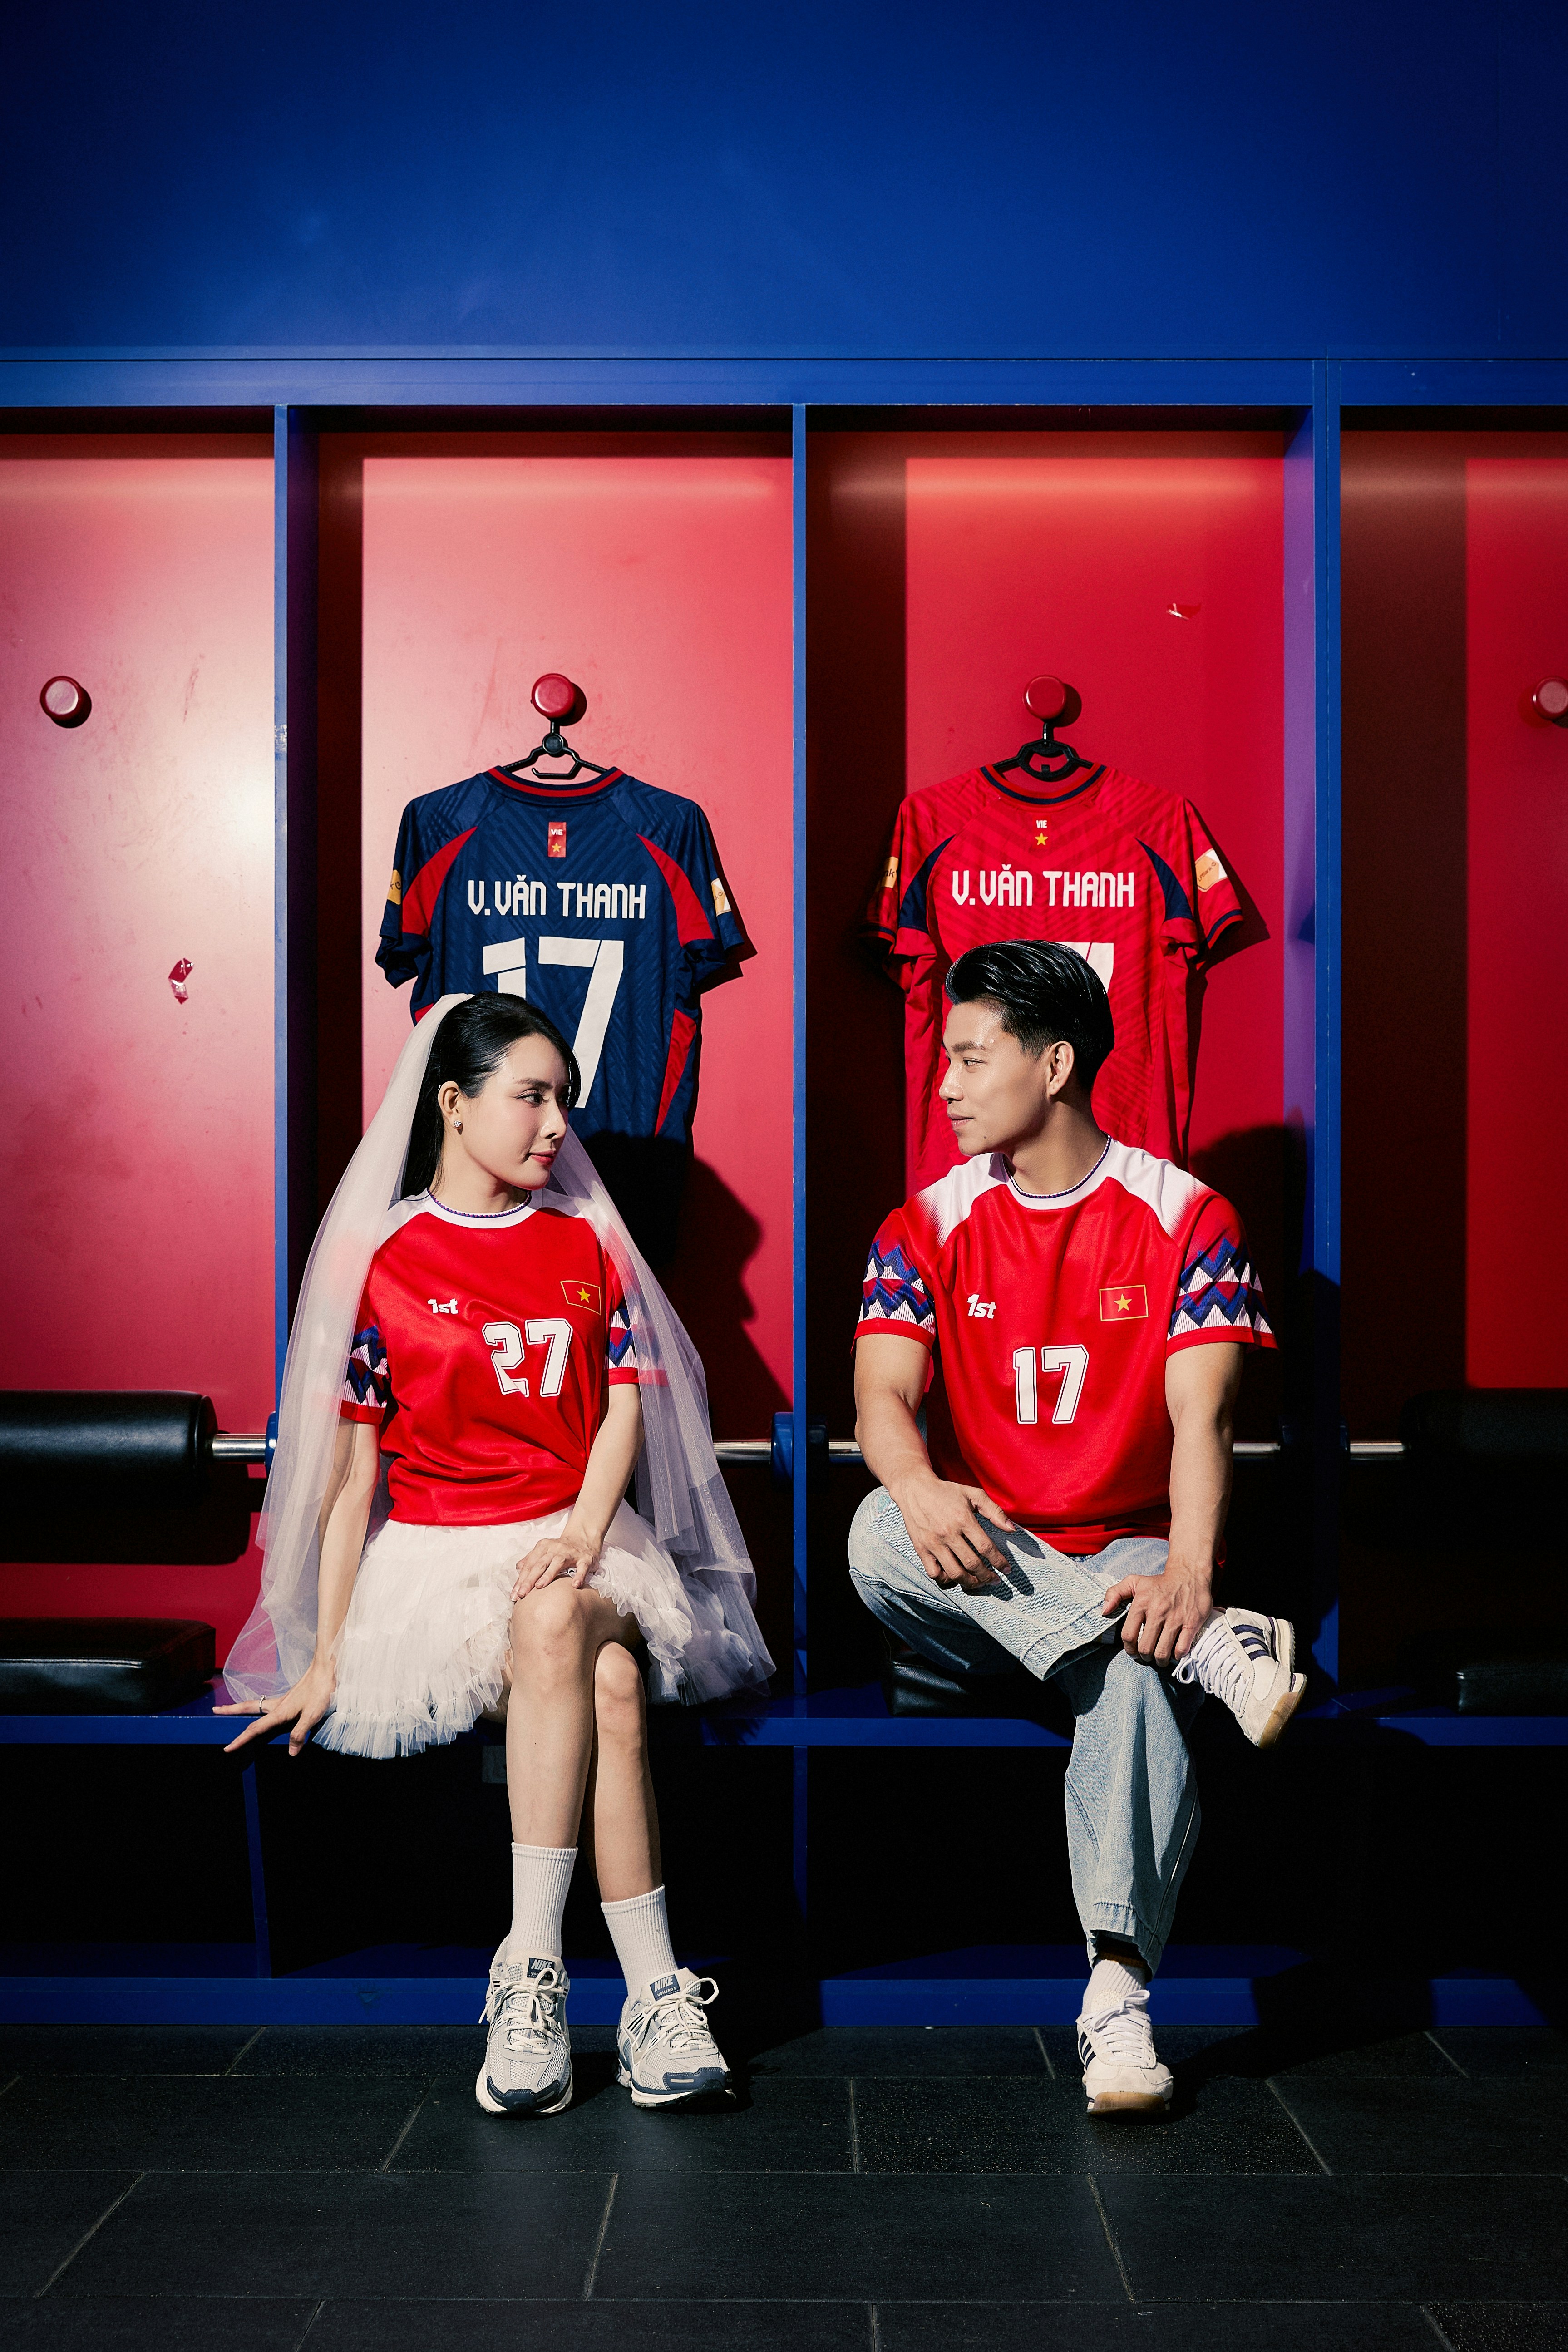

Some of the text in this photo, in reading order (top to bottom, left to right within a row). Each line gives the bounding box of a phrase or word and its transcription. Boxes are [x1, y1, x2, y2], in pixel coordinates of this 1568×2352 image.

[1036, 820, 1047, 828] VIE
[1042, 871, 1134, 907] THANH
[557, 882, 646, 919] THANH
[427, 1298, 459, 1314] 1st
[967, 1294, 996, 1319] 1st
[481, 1318, 573, 1398] 27
[1012, 1344, 1090, 1424] 17
[531, 1959, 552, 1970] NIKE
[654, 1976, 673, 1992] NIKE
[657, 1987, 673, 1997] VOMERO
